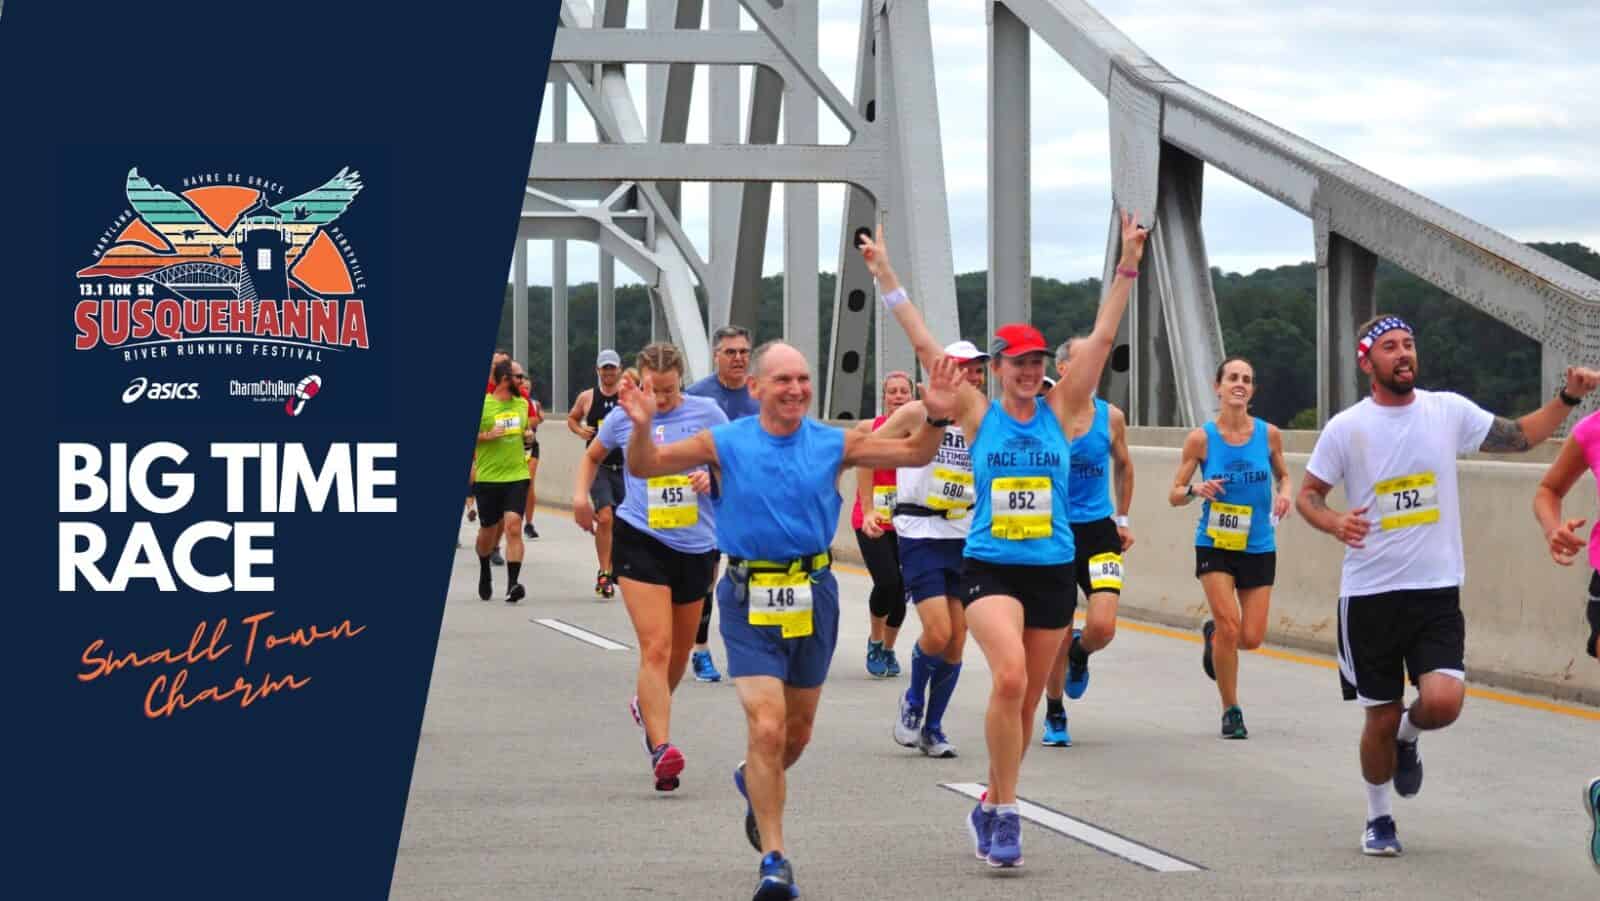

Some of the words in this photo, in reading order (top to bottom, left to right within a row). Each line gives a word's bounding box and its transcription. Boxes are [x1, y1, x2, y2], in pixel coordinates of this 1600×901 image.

[986, 452, 1017, 467] PACE
[1028, 452, 1061, 467] TEAM
[1243, 471, 1267, 484] TEAM
[661, 487, 683, 504] 455
[942, 481, 965, 498] 680
[1008, 490, 1036, 511] 852
[1392, 489, 1422, 511] 752
[1218, 513, 1239, 529] 860
[1101, 561, 1120, 577] 850
[766, 587, 795, 607] 148
